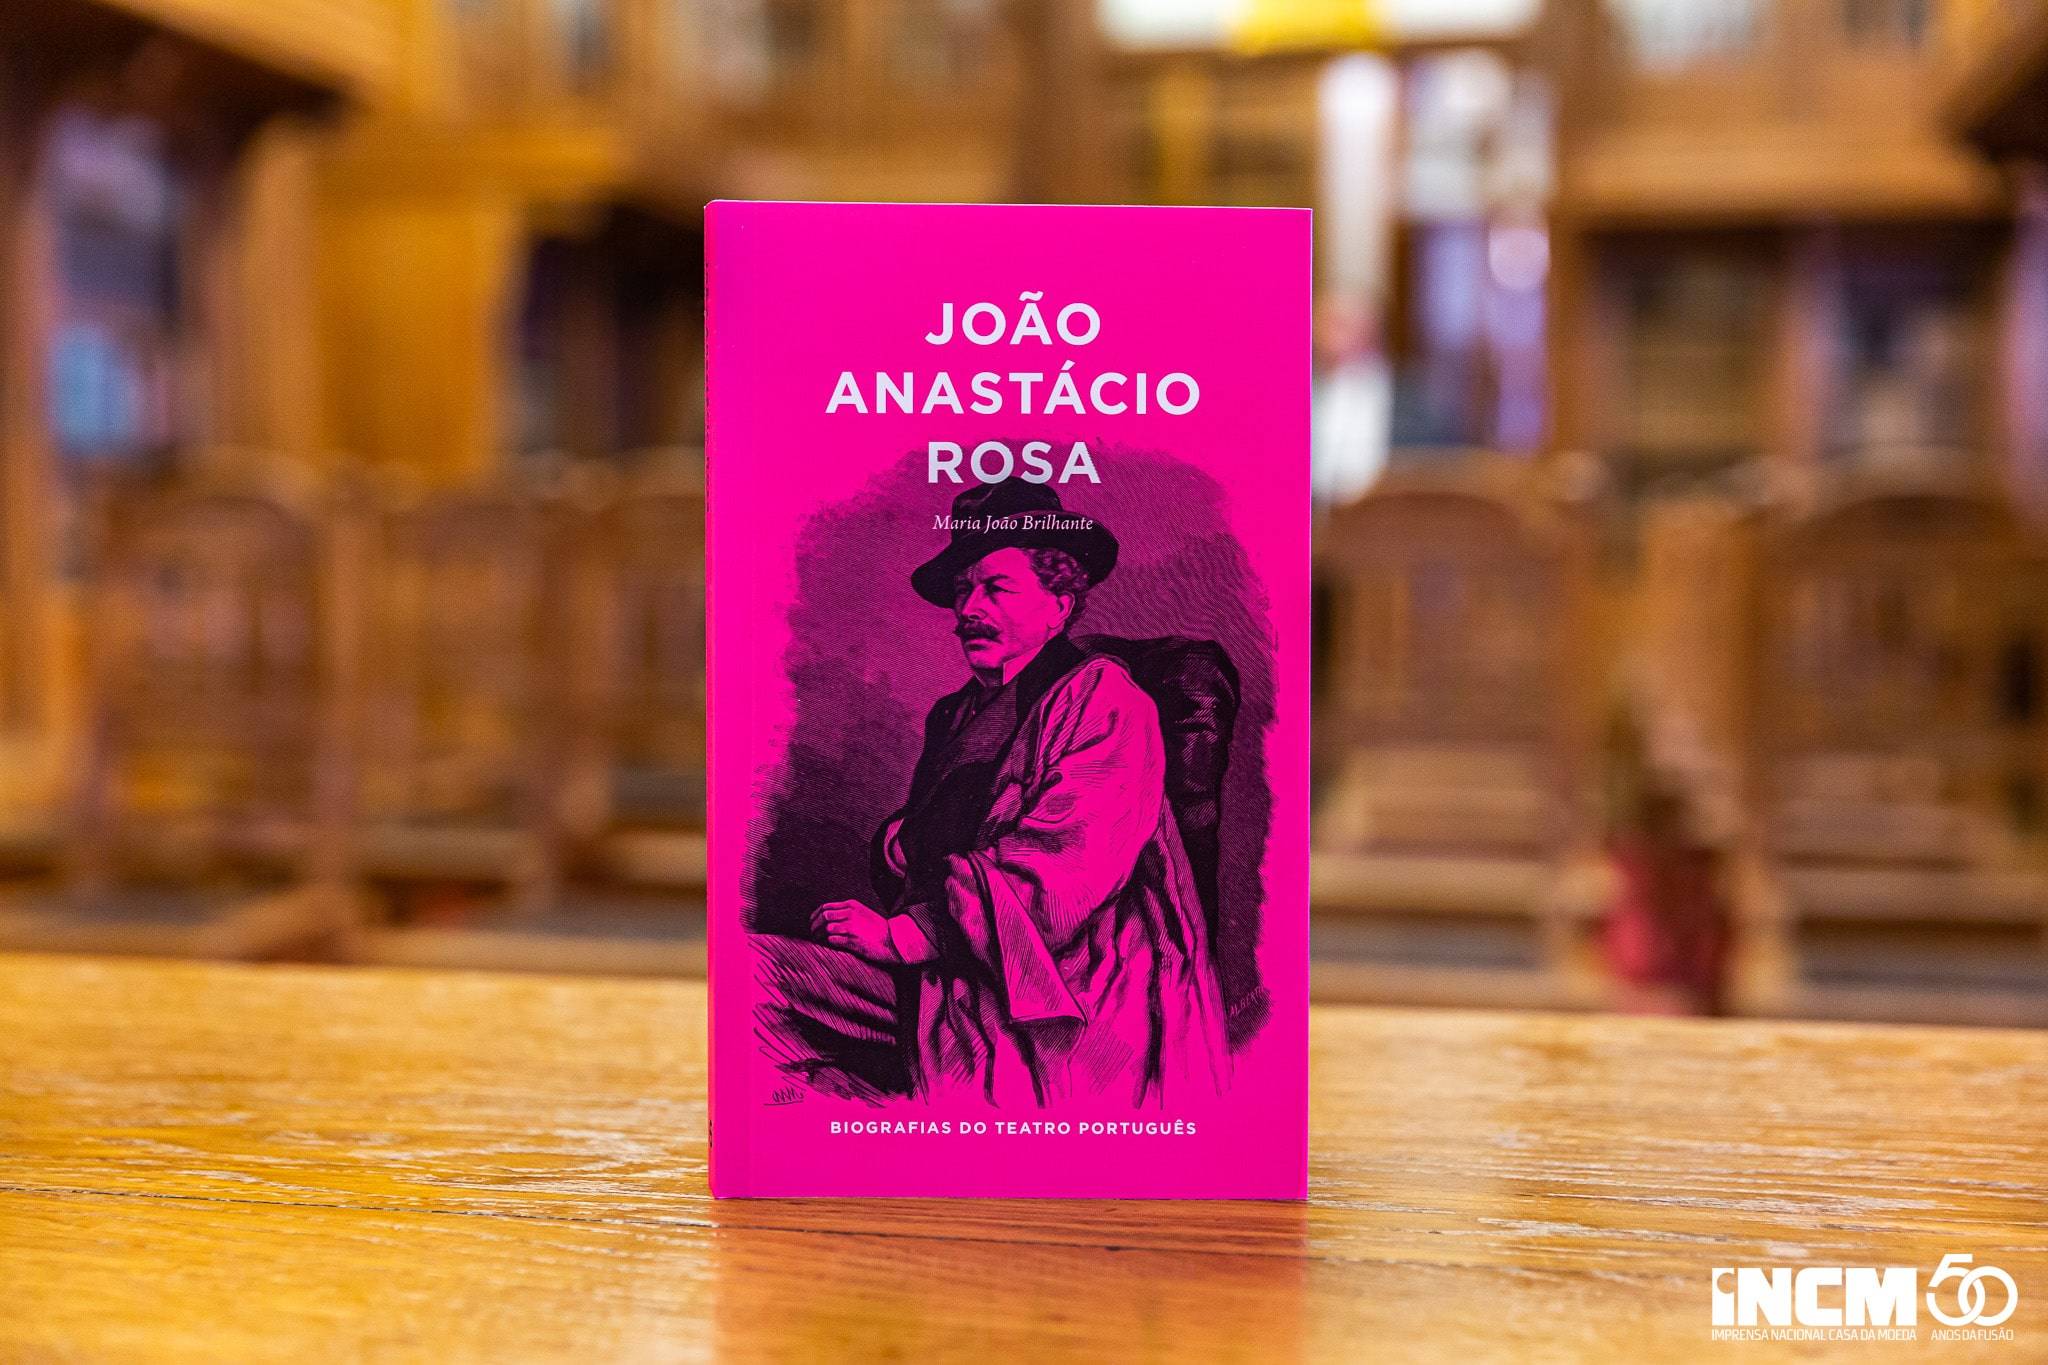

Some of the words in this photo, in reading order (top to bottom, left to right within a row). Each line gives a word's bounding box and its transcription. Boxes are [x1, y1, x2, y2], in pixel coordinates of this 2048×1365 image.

[924, 291, 1101, 345] JOÃO
[826, 360, 1200, 415] ANASTÁCIO
[928, 441, 1101, 484] ROSA
[932, 514, 981, 530] Maria
[983, 514, 1018, 535] João
[1021, 514, 1093, 530] Brilhante
[831, 1121, 951, 1134] BIOGRAFIAS
[959, 1121, 987, 1135] DO
[995, 1121, 1071, 1135] TEATRO
[1079, 1119, 1196, 1135] PORTUGUÊS
